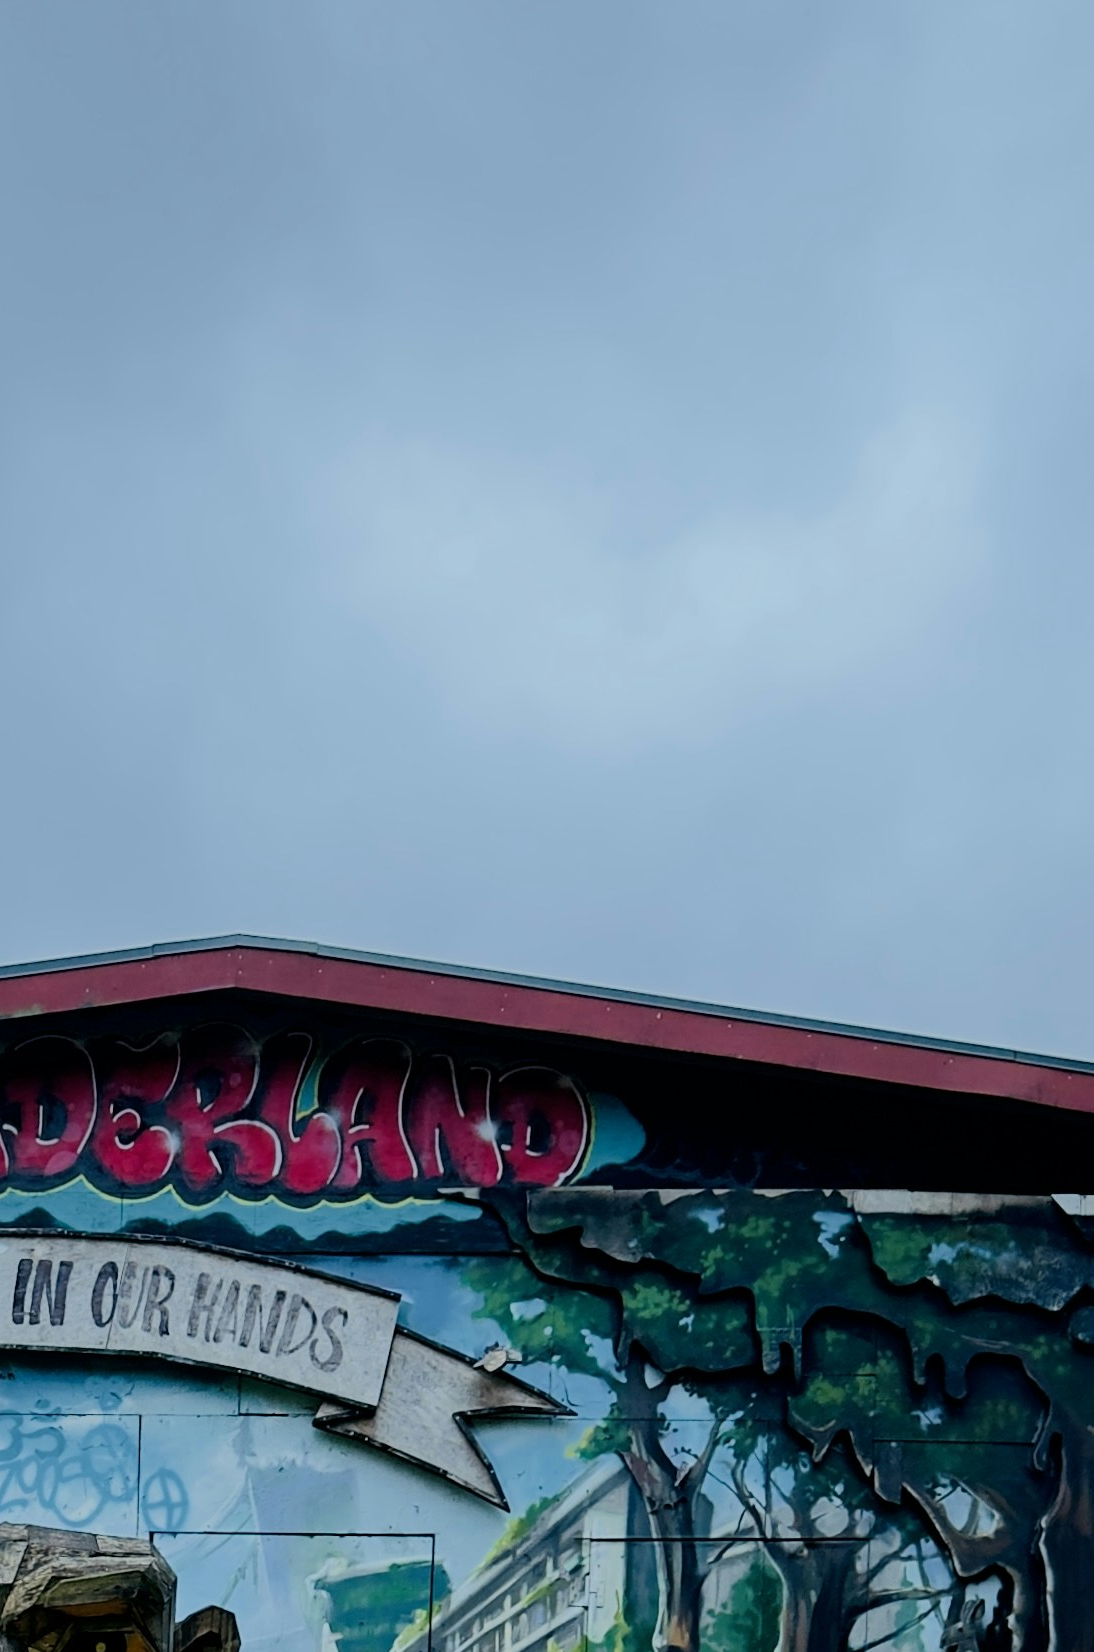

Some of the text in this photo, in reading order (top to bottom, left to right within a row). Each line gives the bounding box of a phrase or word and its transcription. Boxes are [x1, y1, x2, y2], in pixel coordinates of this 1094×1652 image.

[11, 1257, 74, 1327] IN
[90, 1260, 175, 1338] OUR
[185, 1271, 349, 1374] HANDS
